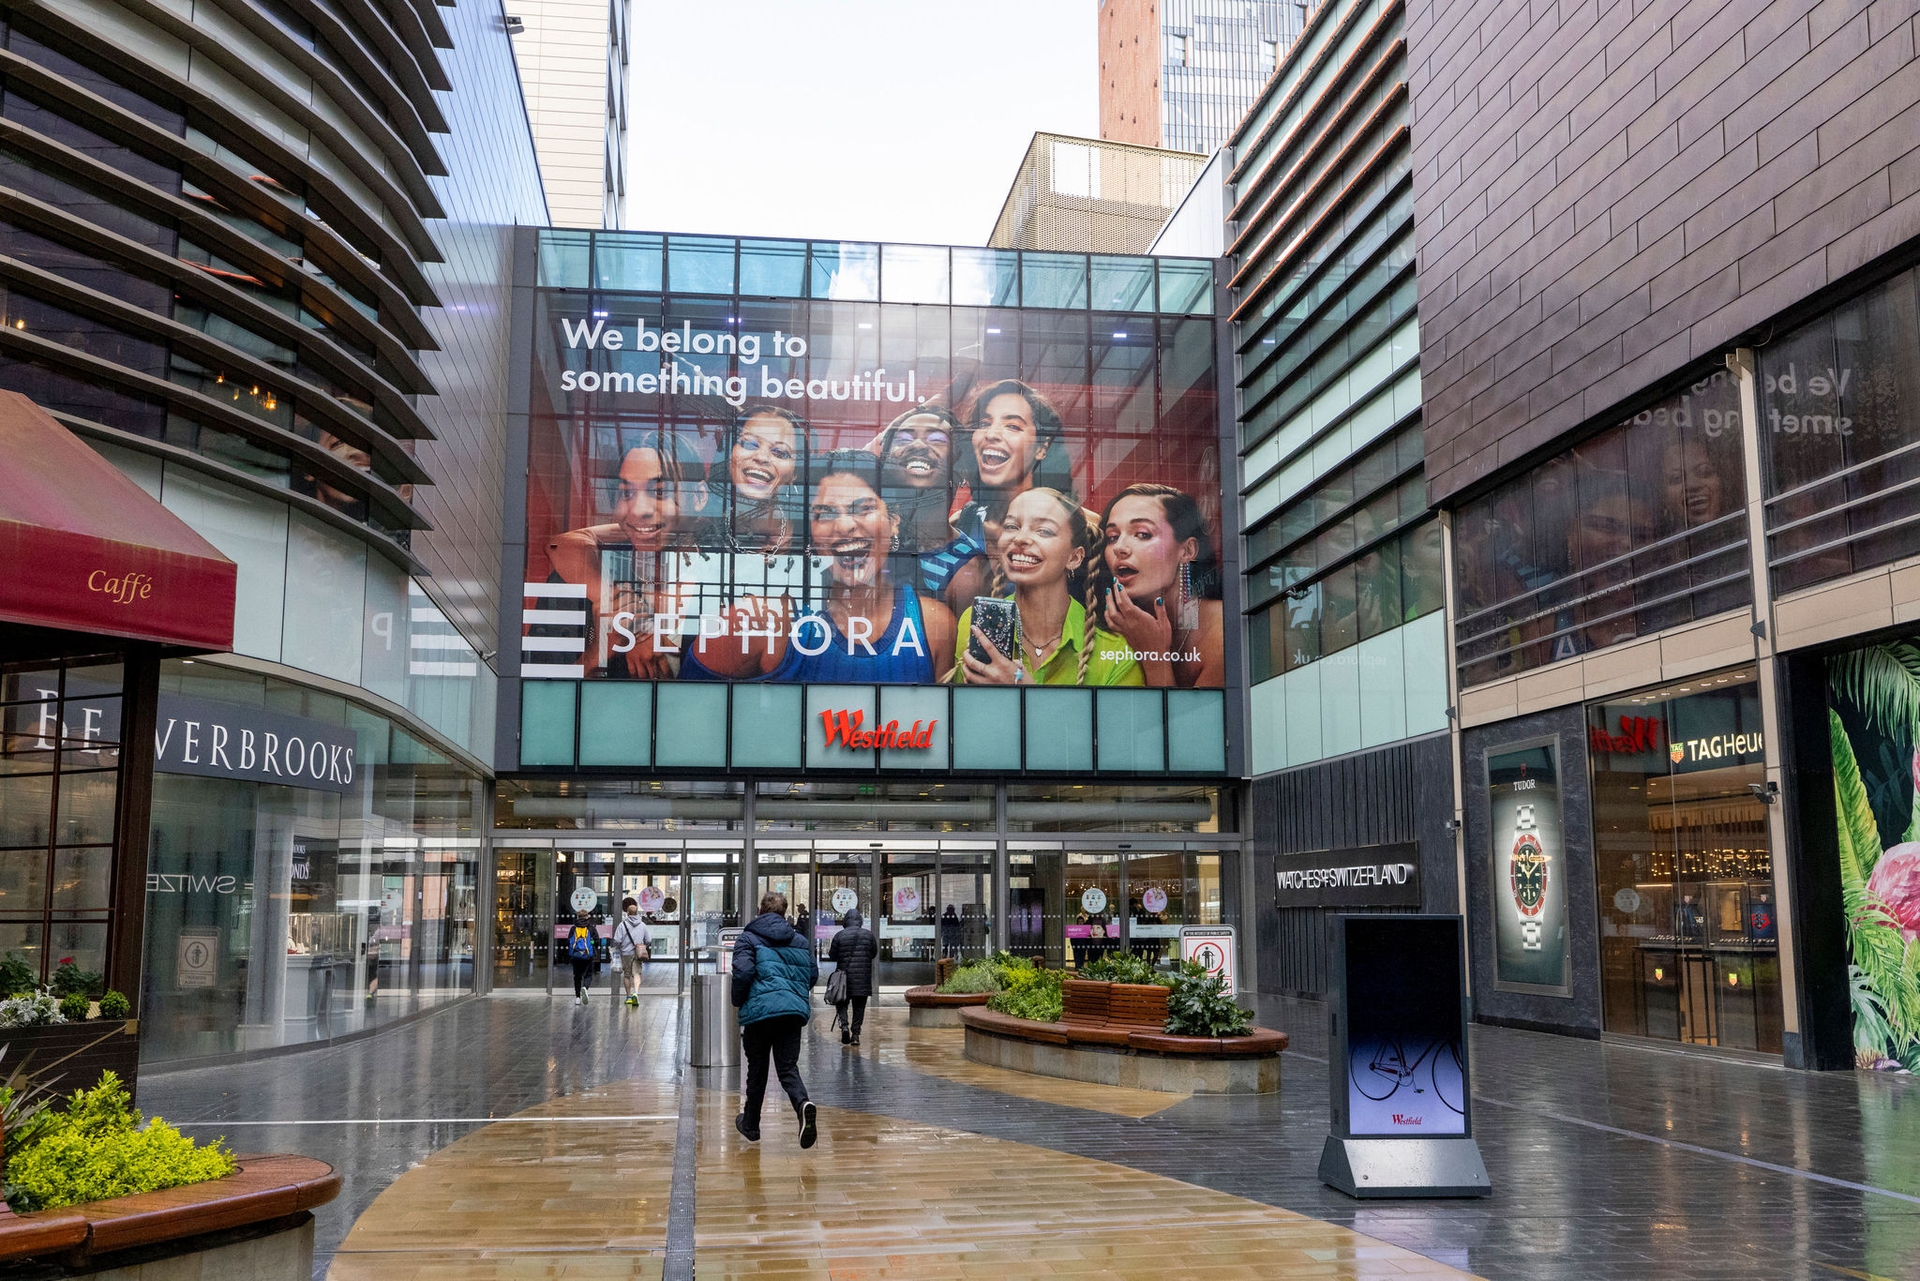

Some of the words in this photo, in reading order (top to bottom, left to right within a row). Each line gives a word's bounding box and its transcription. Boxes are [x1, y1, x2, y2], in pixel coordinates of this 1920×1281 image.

[561, 318, 624, 350] We
[637, 318, 761, 364] belong
[773, 331, 807, 357] to
[560, 361, 747, 406] something
[761, 365, 926, 403] beautiful.
[87, 569, 152, 604] Caffé
[611, 611, 925, 657] SEPHORA
[1100, 645, 1202, 664] sephora.co.uk
[34, 688, 353, 784] BEVERBROOKS
[818, 709, 938, 749] Westfield
[1513, 778, 1536, 791] TUDOR
[1276, 869, 1321, 889] WATCHES
[1329, 863, 1407, 888] SWITZERLAND
[1392, 1113, 1423, 1126] Westfield
